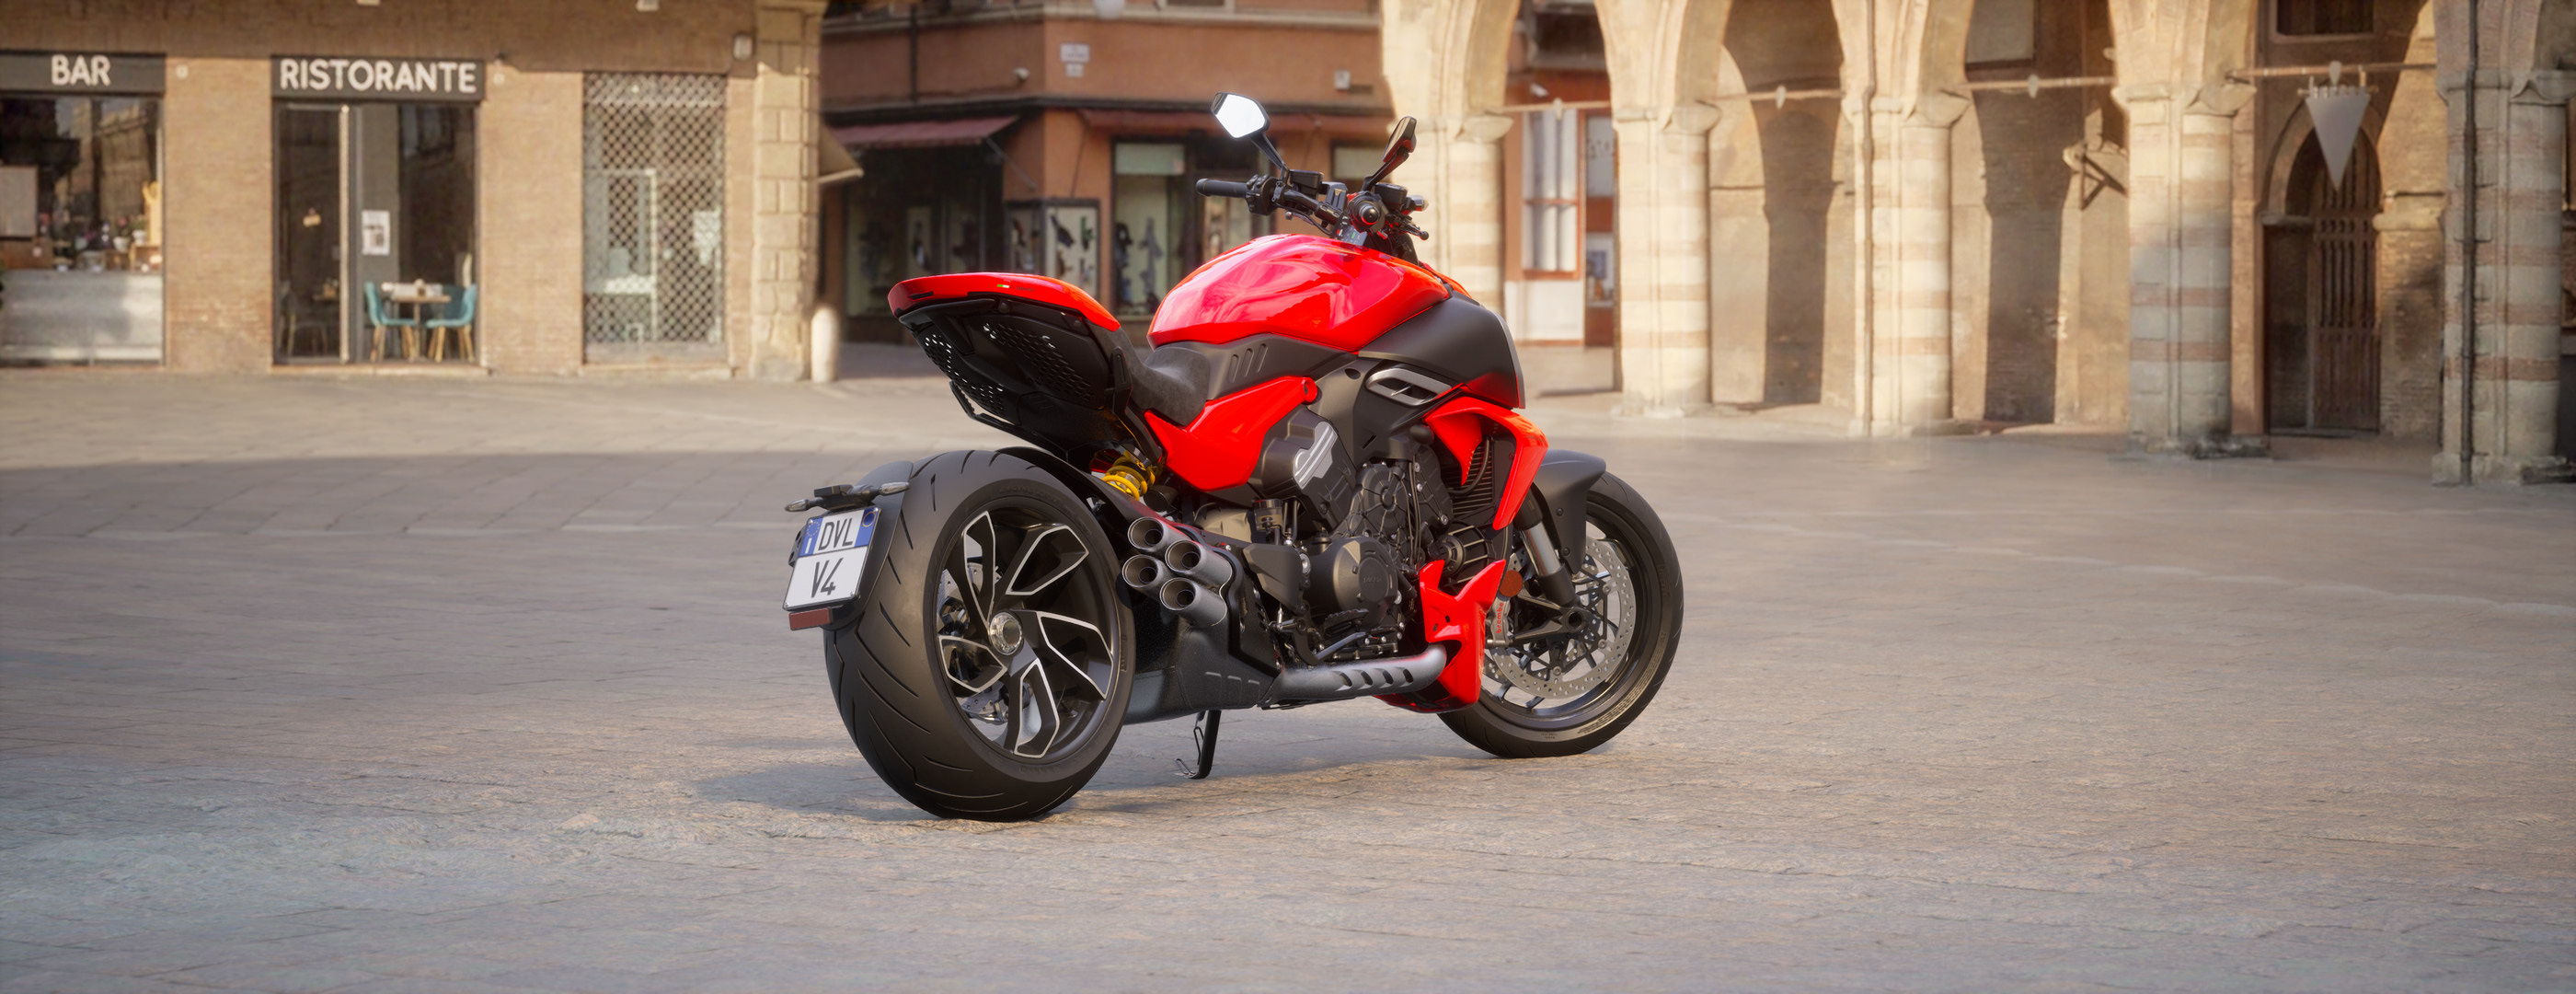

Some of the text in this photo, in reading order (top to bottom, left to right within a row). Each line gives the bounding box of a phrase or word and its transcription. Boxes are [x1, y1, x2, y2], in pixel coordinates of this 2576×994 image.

[52, 53, 111, 87] BAR
[280, 58, 477, 94] RISTORANTE
[818, 518, 853, 551] DVL
[811, 558, 844, 598] V4
[1495, 602, 1504, 634] brembo
